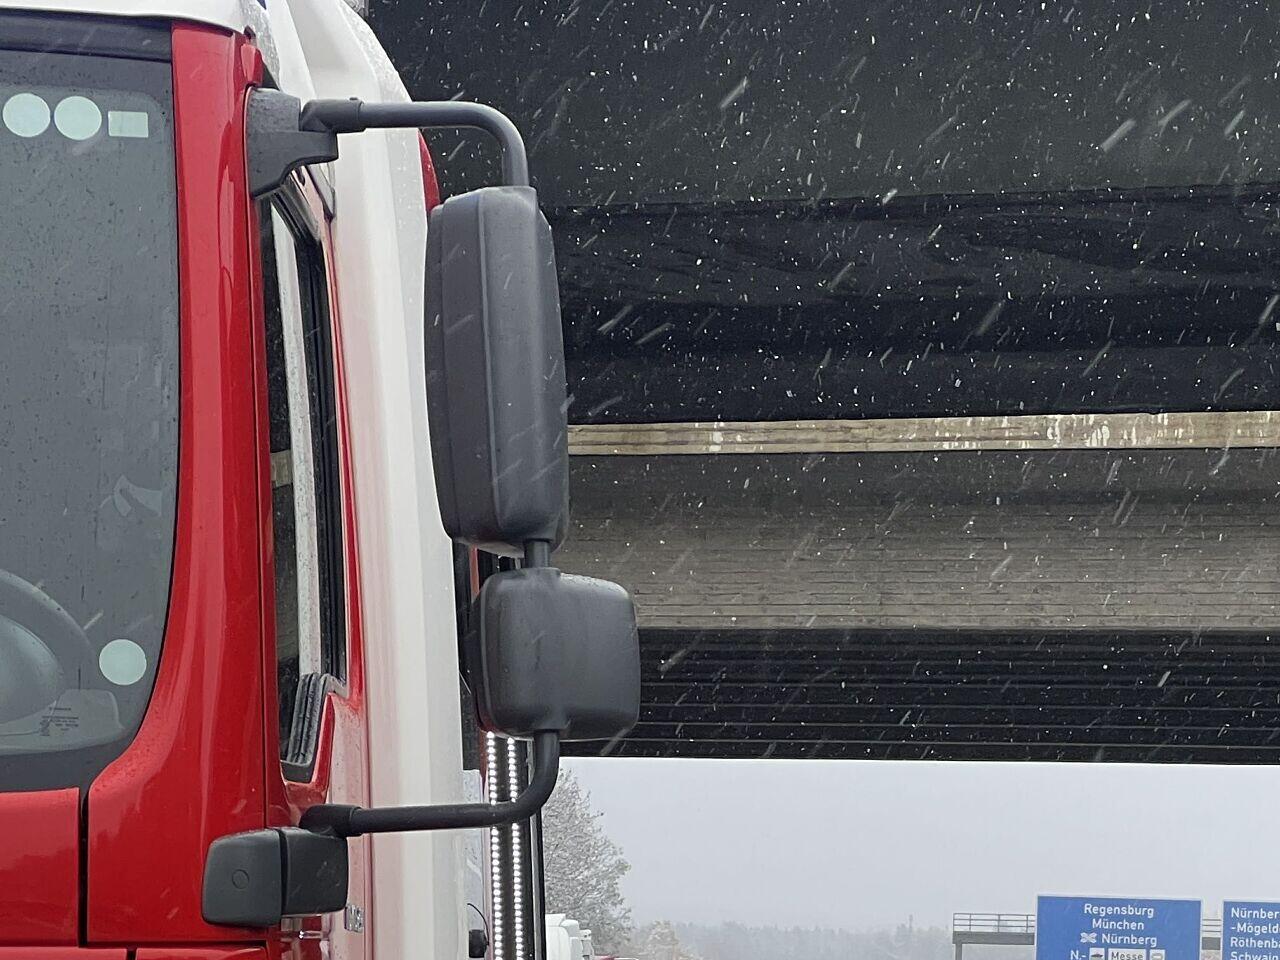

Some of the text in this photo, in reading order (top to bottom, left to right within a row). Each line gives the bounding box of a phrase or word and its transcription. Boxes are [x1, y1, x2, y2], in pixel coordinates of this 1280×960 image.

[1084, 903, 1154, 917] Regensburg
[1092, 918, 1144, 930] München
[1101, 933, 1158, 947] Nürnberg
[1111, 952, 1143, 960] Messe
